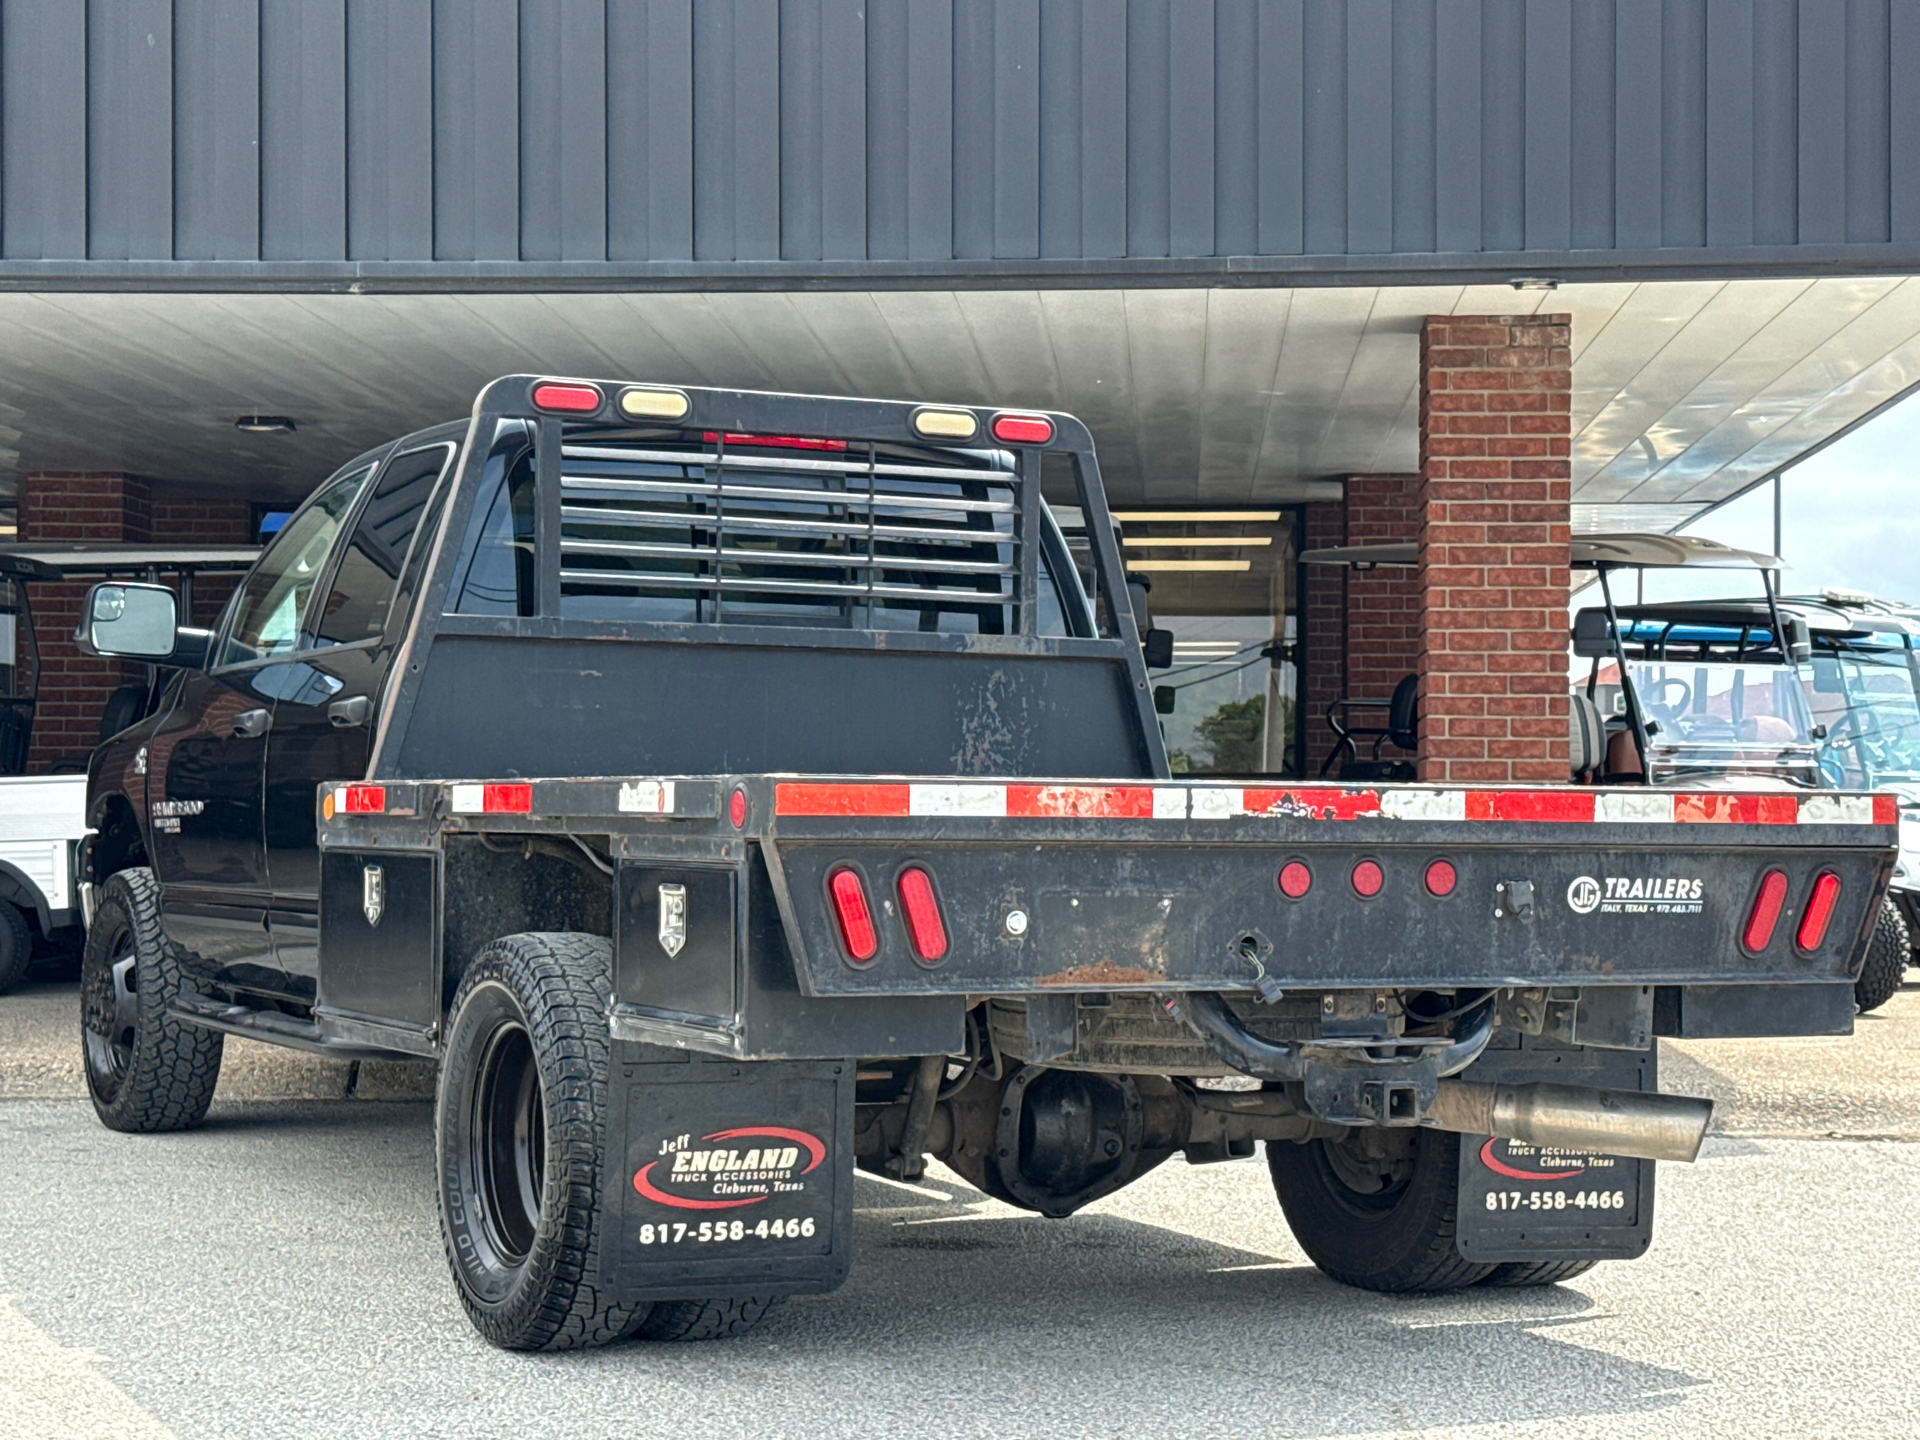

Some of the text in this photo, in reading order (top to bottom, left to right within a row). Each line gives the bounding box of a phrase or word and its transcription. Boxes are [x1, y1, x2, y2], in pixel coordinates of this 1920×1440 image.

[1605, 878, 1704, 899] TRAILERS
[1601, 904, 1622, 914] ITALY,
[1625, 904, 1648, 913] TEXAS
[659, 1134, 690, 1155] Jeff
[1508, 1147, 1535, 1156] TRUCK
[446, 1095, 465, 1226] COUNTRY
[672, 1147, 798, 1172] ENGLAND
[1539, 1156, 1615, 1168] Cleburne, Texas
[670, 1170, 791, 1182] TRUCK ACCESSORIES
[713, 1180, 804, 1194] Cleburne, Texas
[1485, 1190, 1625, 1210] 817-558-4466
[639, 1217, 815, 1244] 817-558-4466
[457, 1233, 487, 1276] WILD
